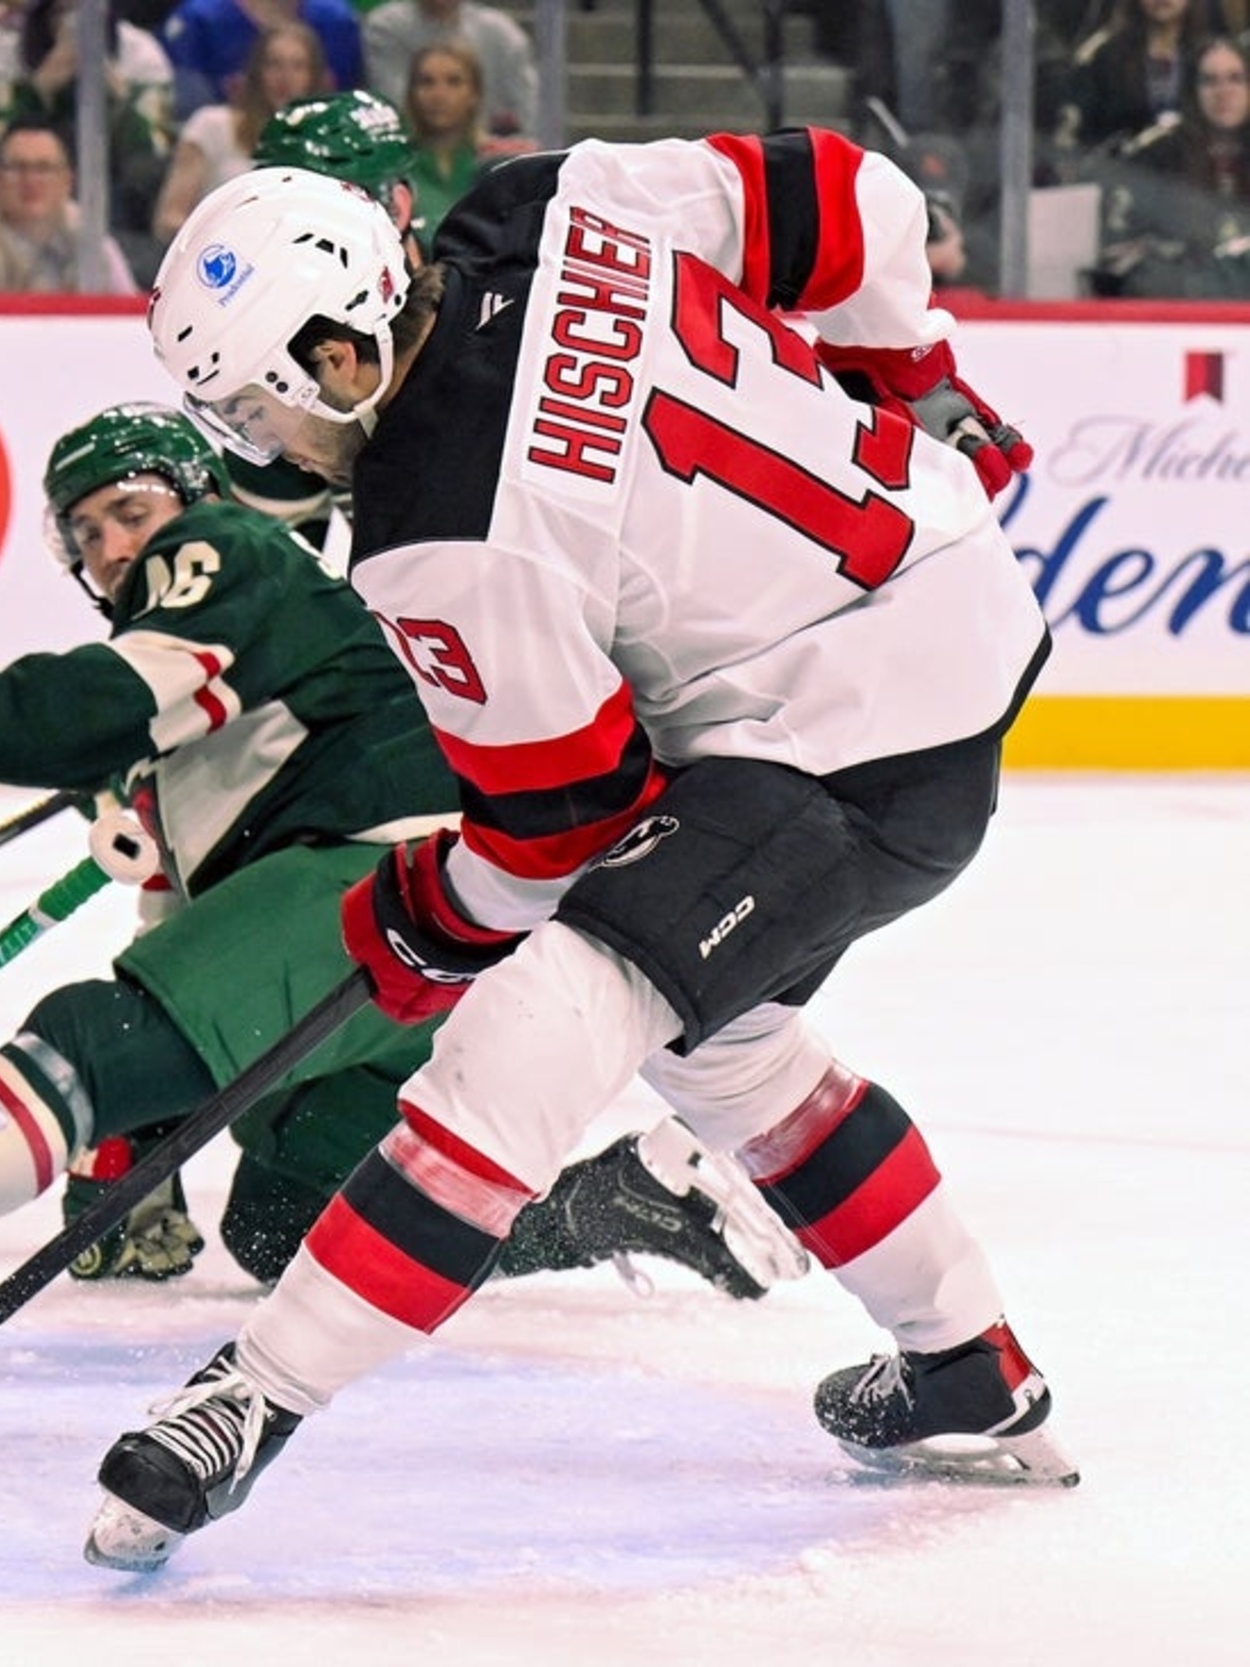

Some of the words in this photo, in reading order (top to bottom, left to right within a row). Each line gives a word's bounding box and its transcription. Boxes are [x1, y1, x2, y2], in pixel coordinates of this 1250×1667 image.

[527, 205, 652, 485] HISCHIER
[640, 249, 916, 592] 13
[698, 894, 756, 960] CCM
